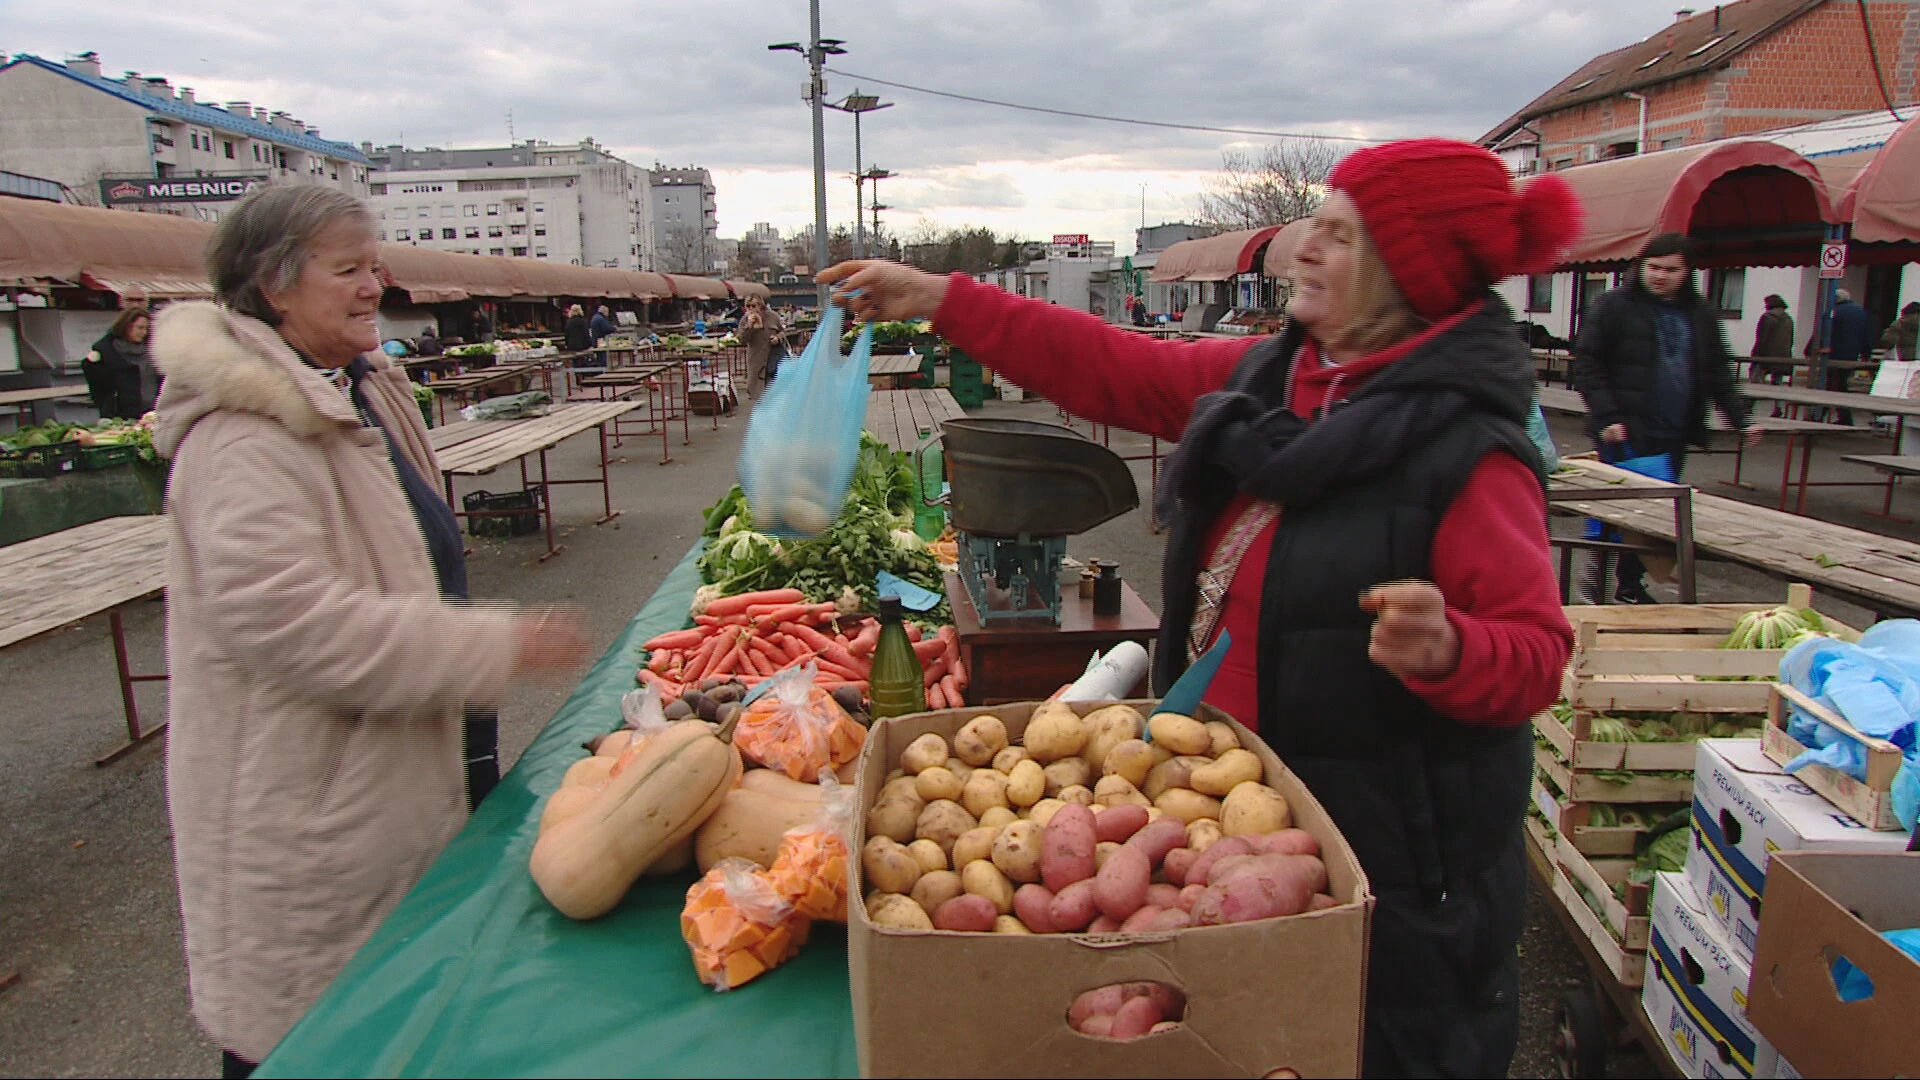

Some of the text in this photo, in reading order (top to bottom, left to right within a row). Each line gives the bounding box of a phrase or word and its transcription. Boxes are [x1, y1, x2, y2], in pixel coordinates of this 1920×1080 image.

[149, 181, 258, 197] MESNICA
[1712, 769, 1766, 828] PREMIUM PACK
[1674, 905, 1732, 974] PREMIUM PACK
